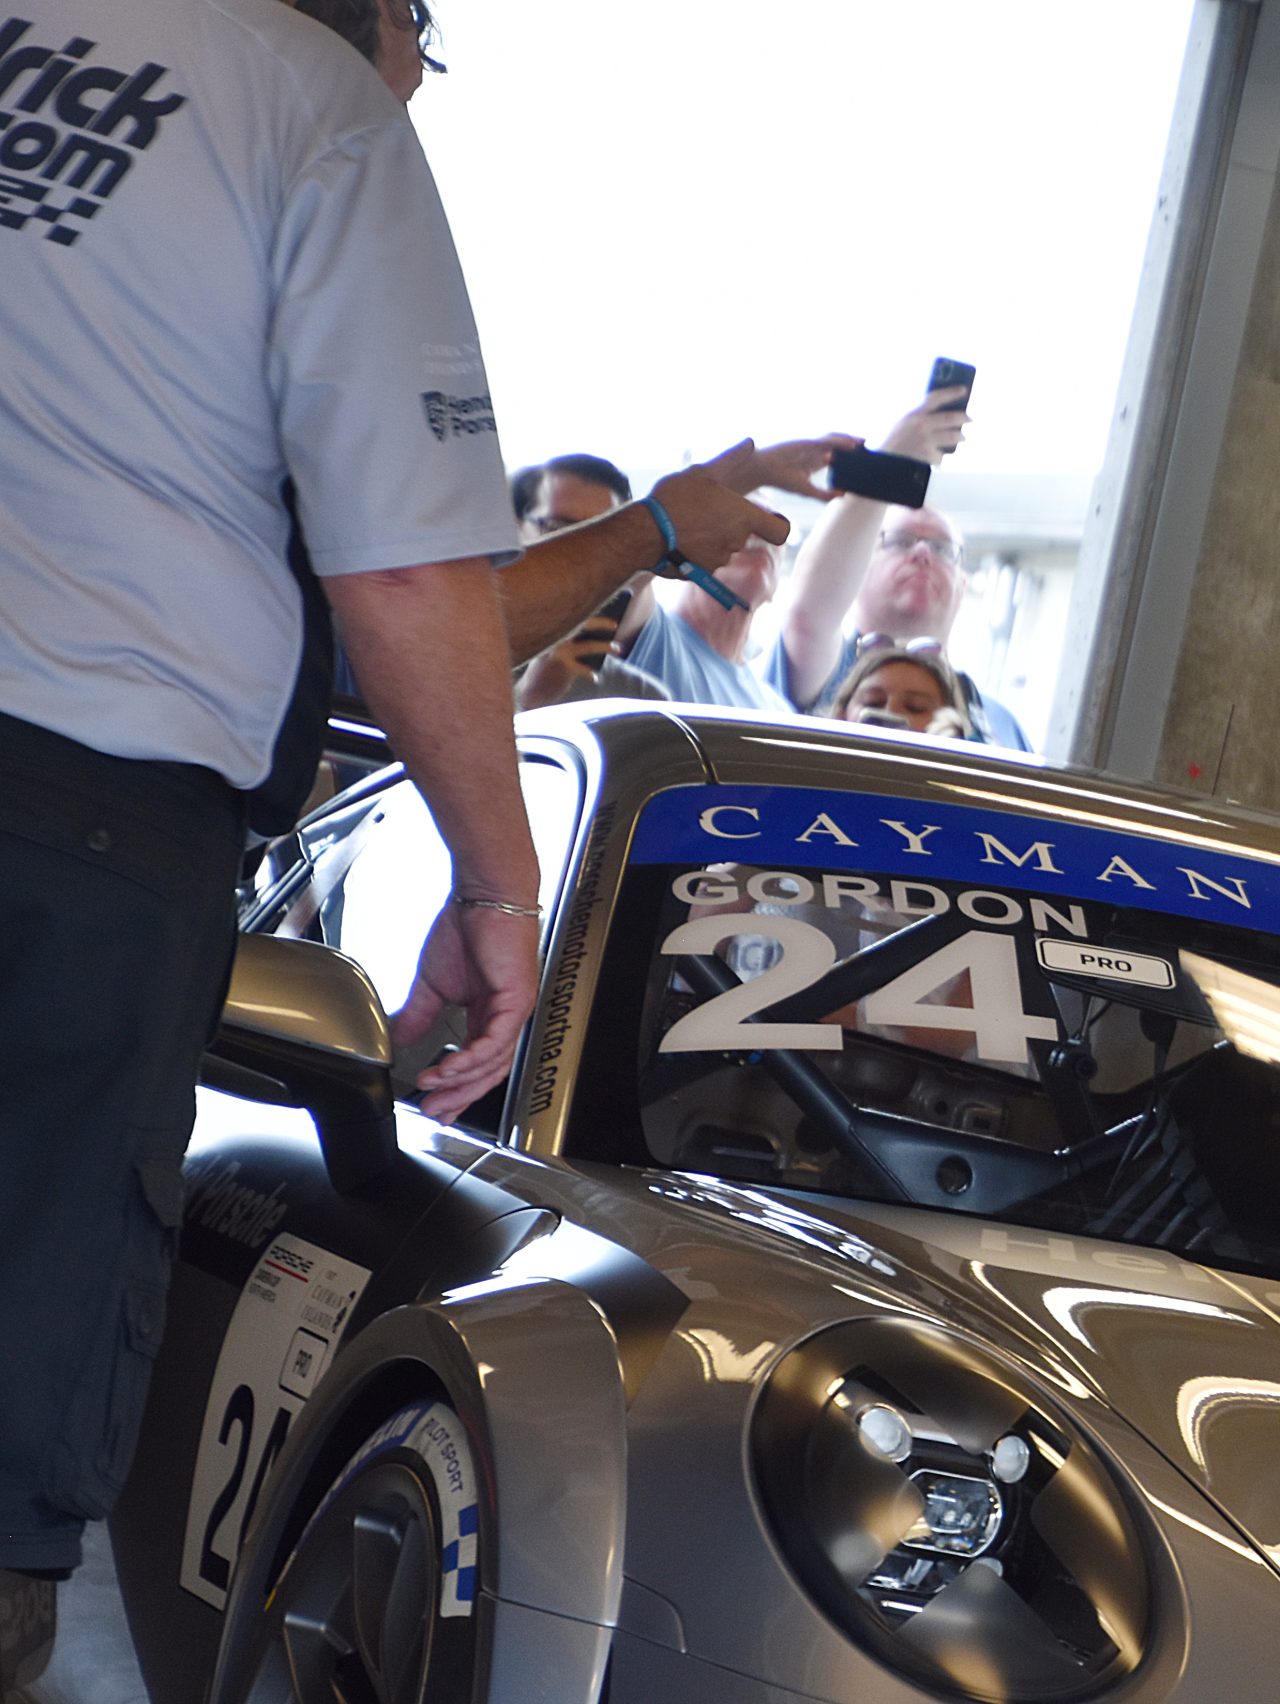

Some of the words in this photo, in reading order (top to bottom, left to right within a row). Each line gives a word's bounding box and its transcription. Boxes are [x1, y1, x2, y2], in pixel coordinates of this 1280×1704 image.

[0, 17, 189, 151] rick
[0, 112, 134, 198] om
[700, 805, 1252, 909] CAYMAN
[671, 870, 1088, 938] GORDON
[658, 913, 1059, 1064] 24
[1080, 954, 1132, 972] PRO
[420, 1416, 450, 1446] PILOT
[441, 1443, 463, 1493] SPORT
